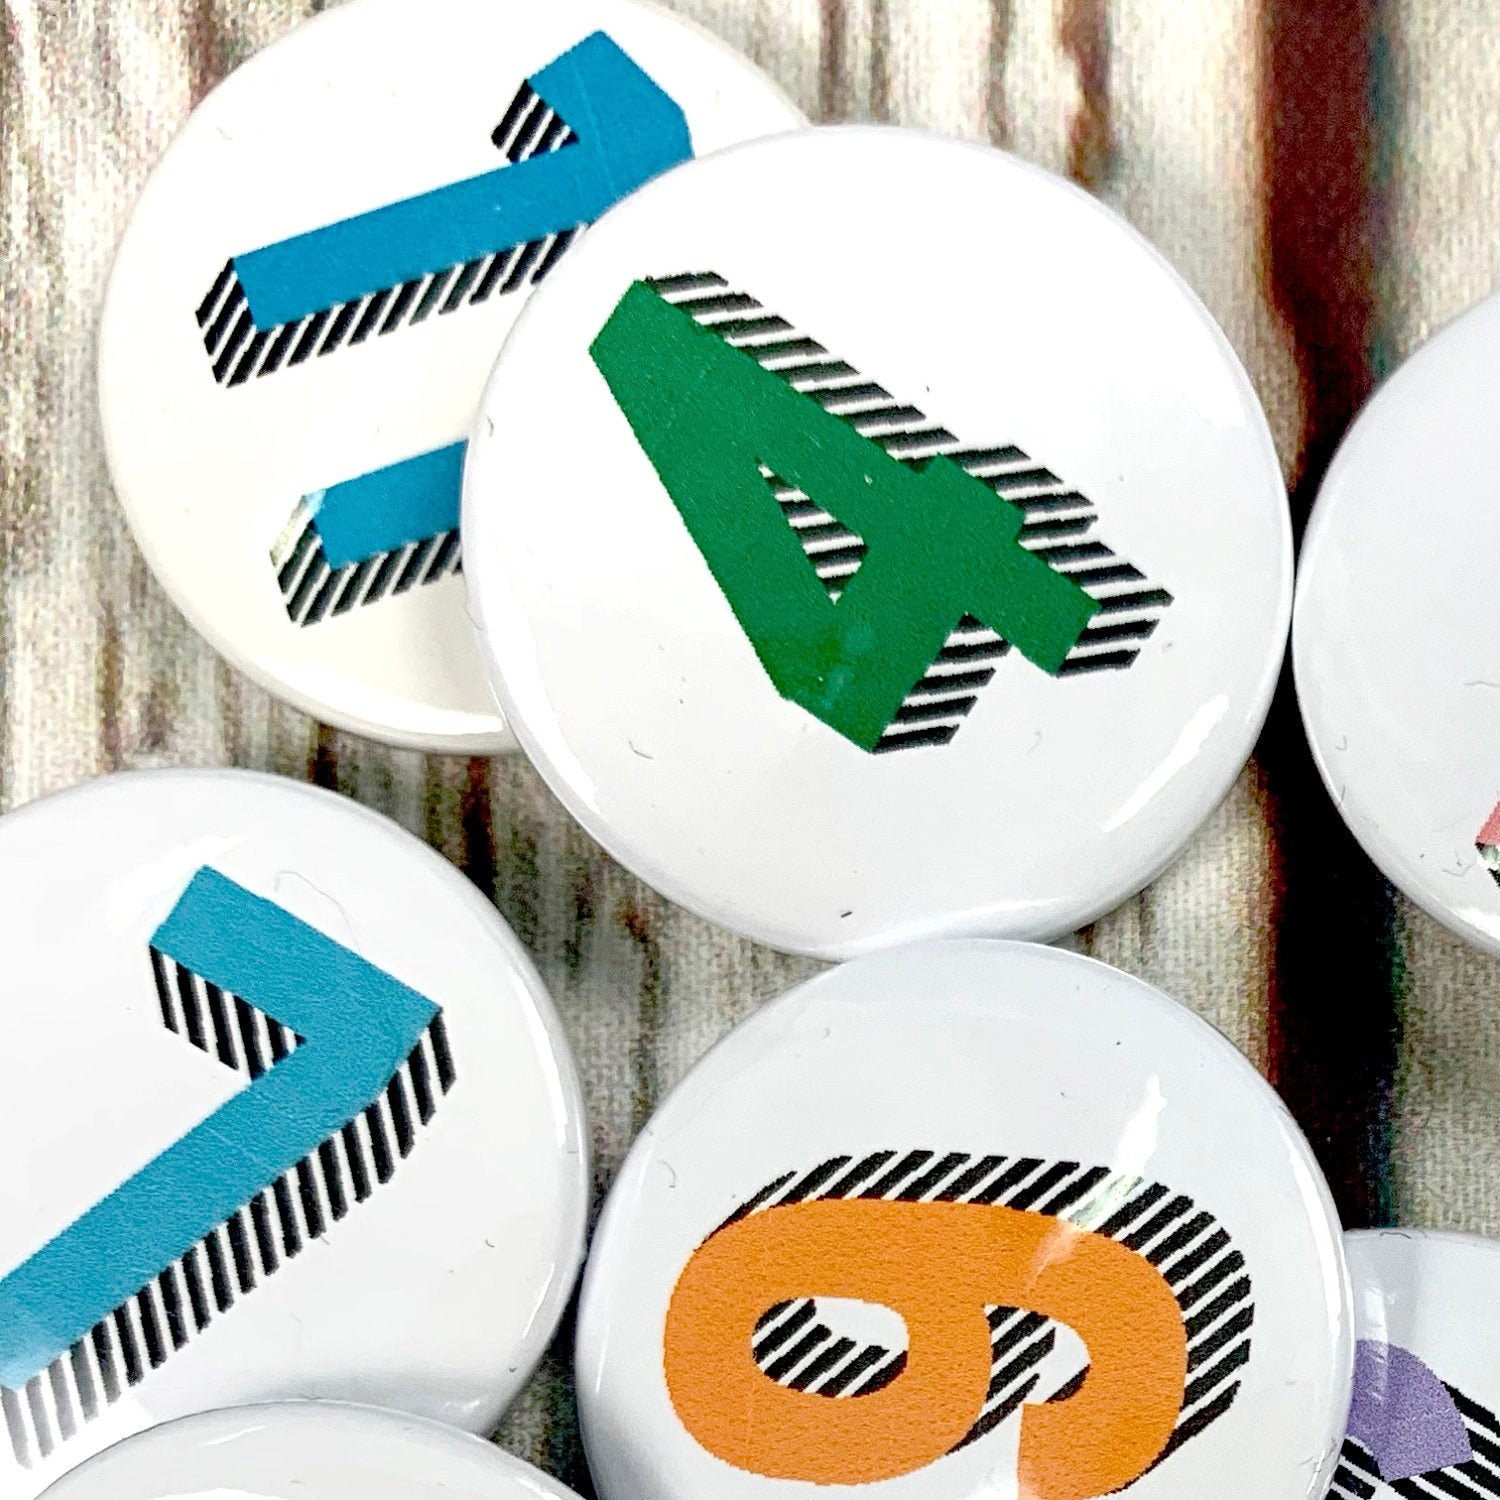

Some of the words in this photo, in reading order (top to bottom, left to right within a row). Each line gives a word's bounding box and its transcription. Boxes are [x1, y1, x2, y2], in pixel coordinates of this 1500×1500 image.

[199, 30, 691, 626] 1
[590, 270, 1171, 752] 4
[0, 865, 457, 1462] 7
